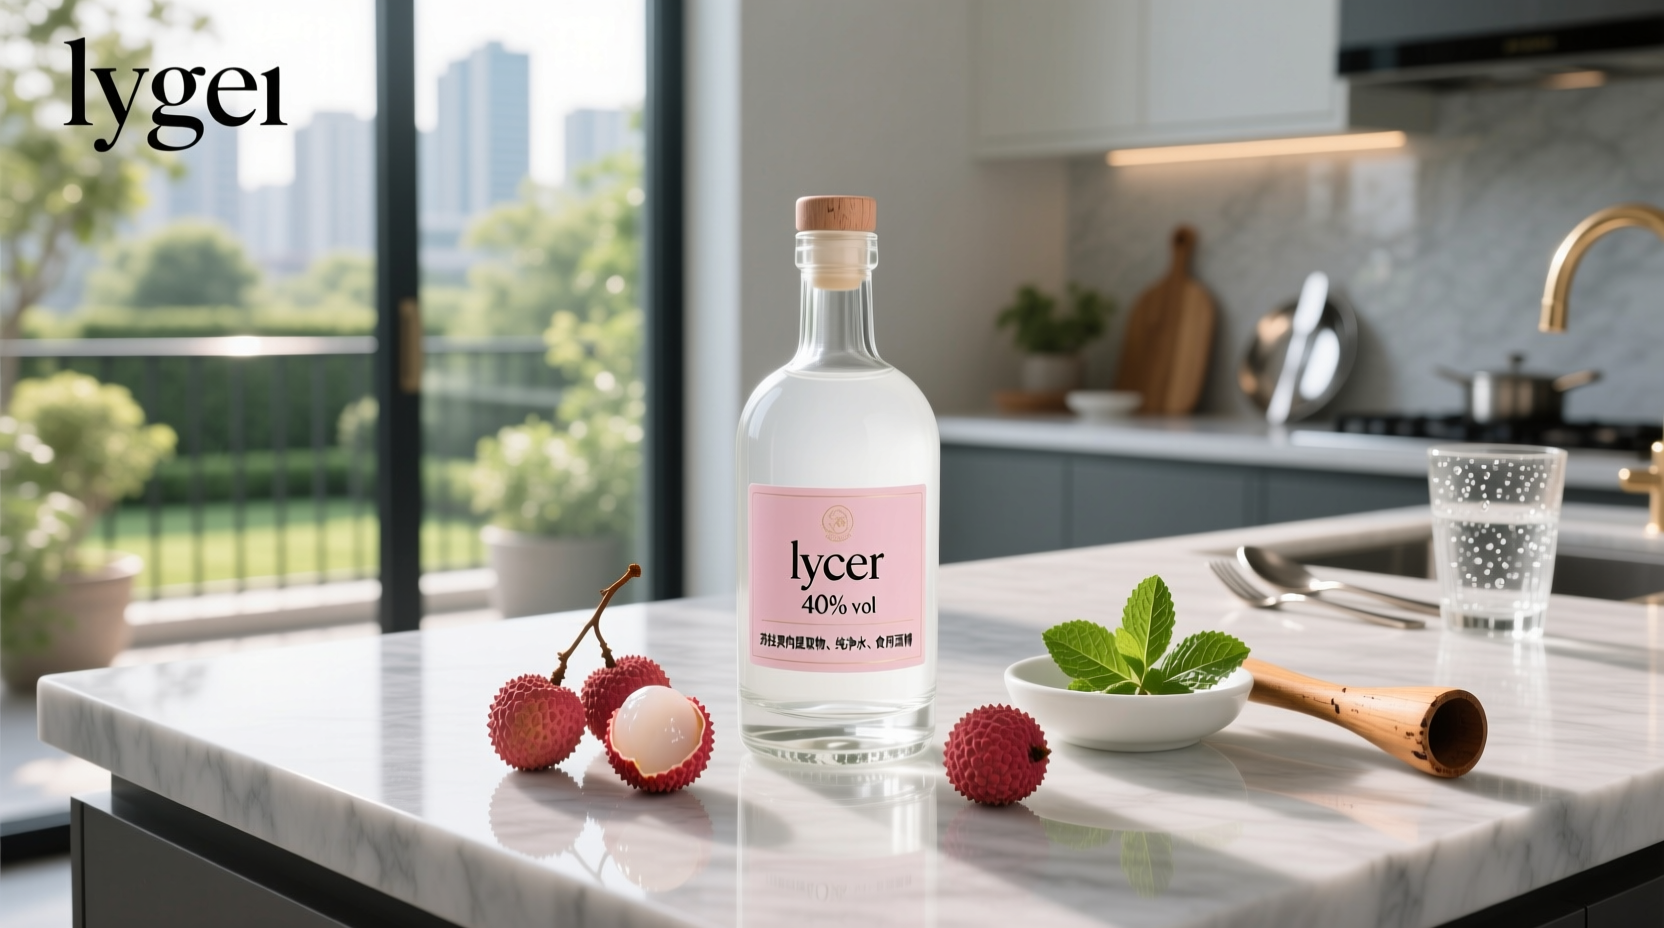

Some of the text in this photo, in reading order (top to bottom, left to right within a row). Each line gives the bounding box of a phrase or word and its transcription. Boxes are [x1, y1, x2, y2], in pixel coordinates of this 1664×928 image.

[791, 540, 884, 591] lycer
[802, 594, 875, 615] 40% vol
